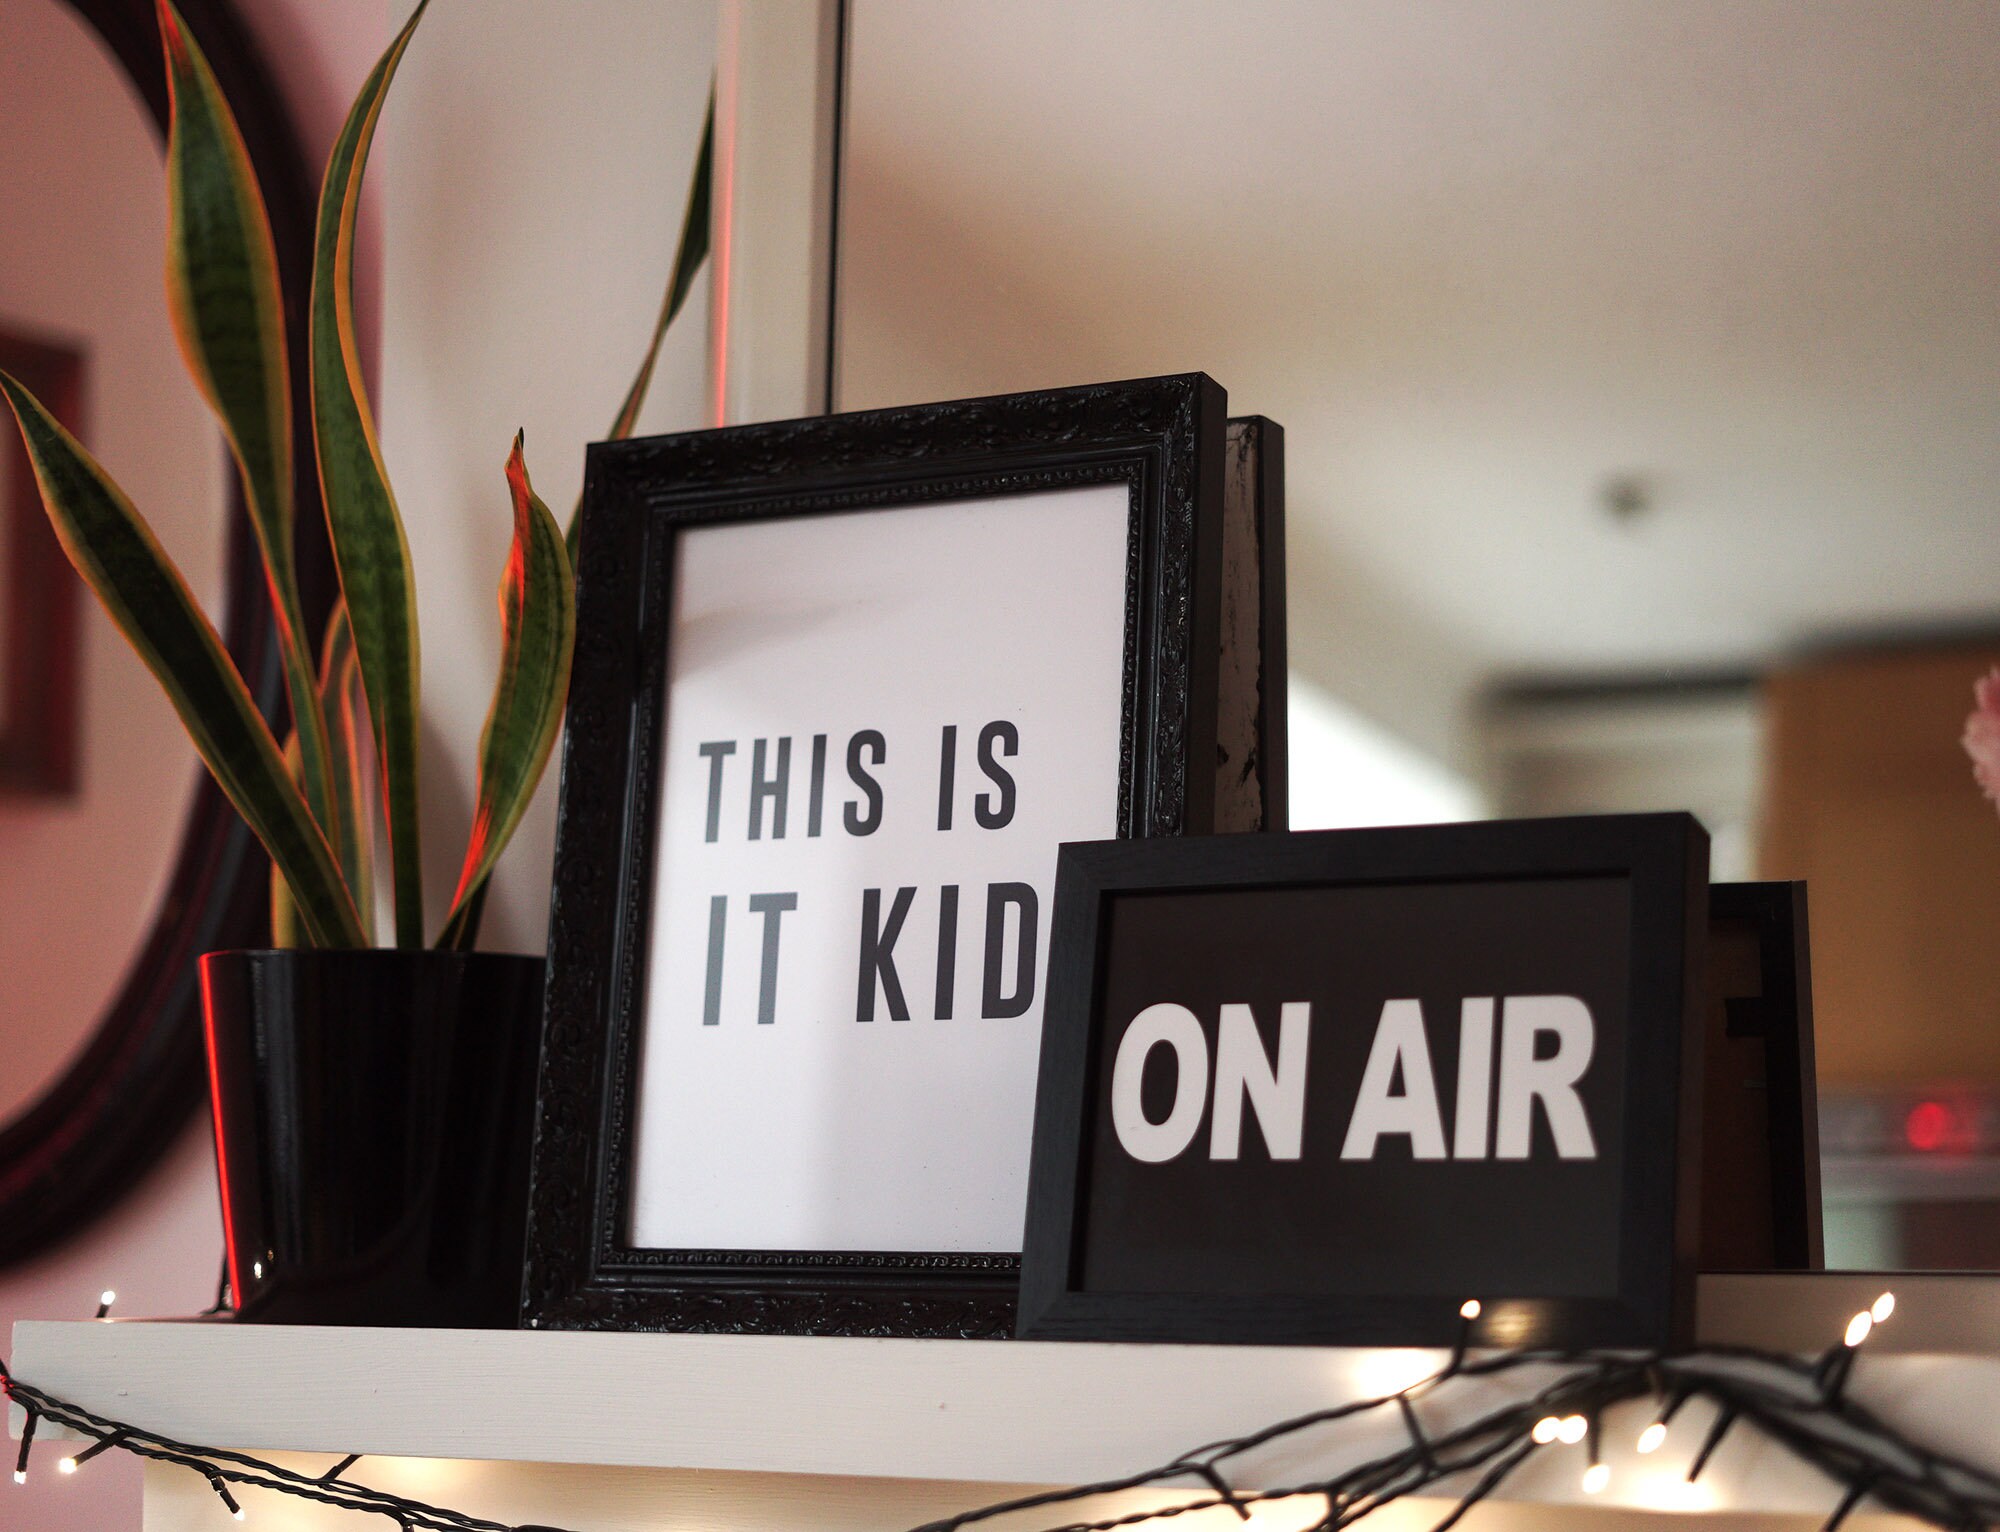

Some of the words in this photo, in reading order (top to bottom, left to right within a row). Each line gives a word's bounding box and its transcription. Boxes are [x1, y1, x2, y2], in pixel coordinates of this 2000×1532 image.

[699, 729, 887, 843] THIS
[937, 720, 1019, 831] IS
[702, 892, 798, 1026] IT
[856, 882, 1039, 1022] KID
[1111, 1001, 1311, 1163] ON
[1340, 995, 1598, 1161] AIR
